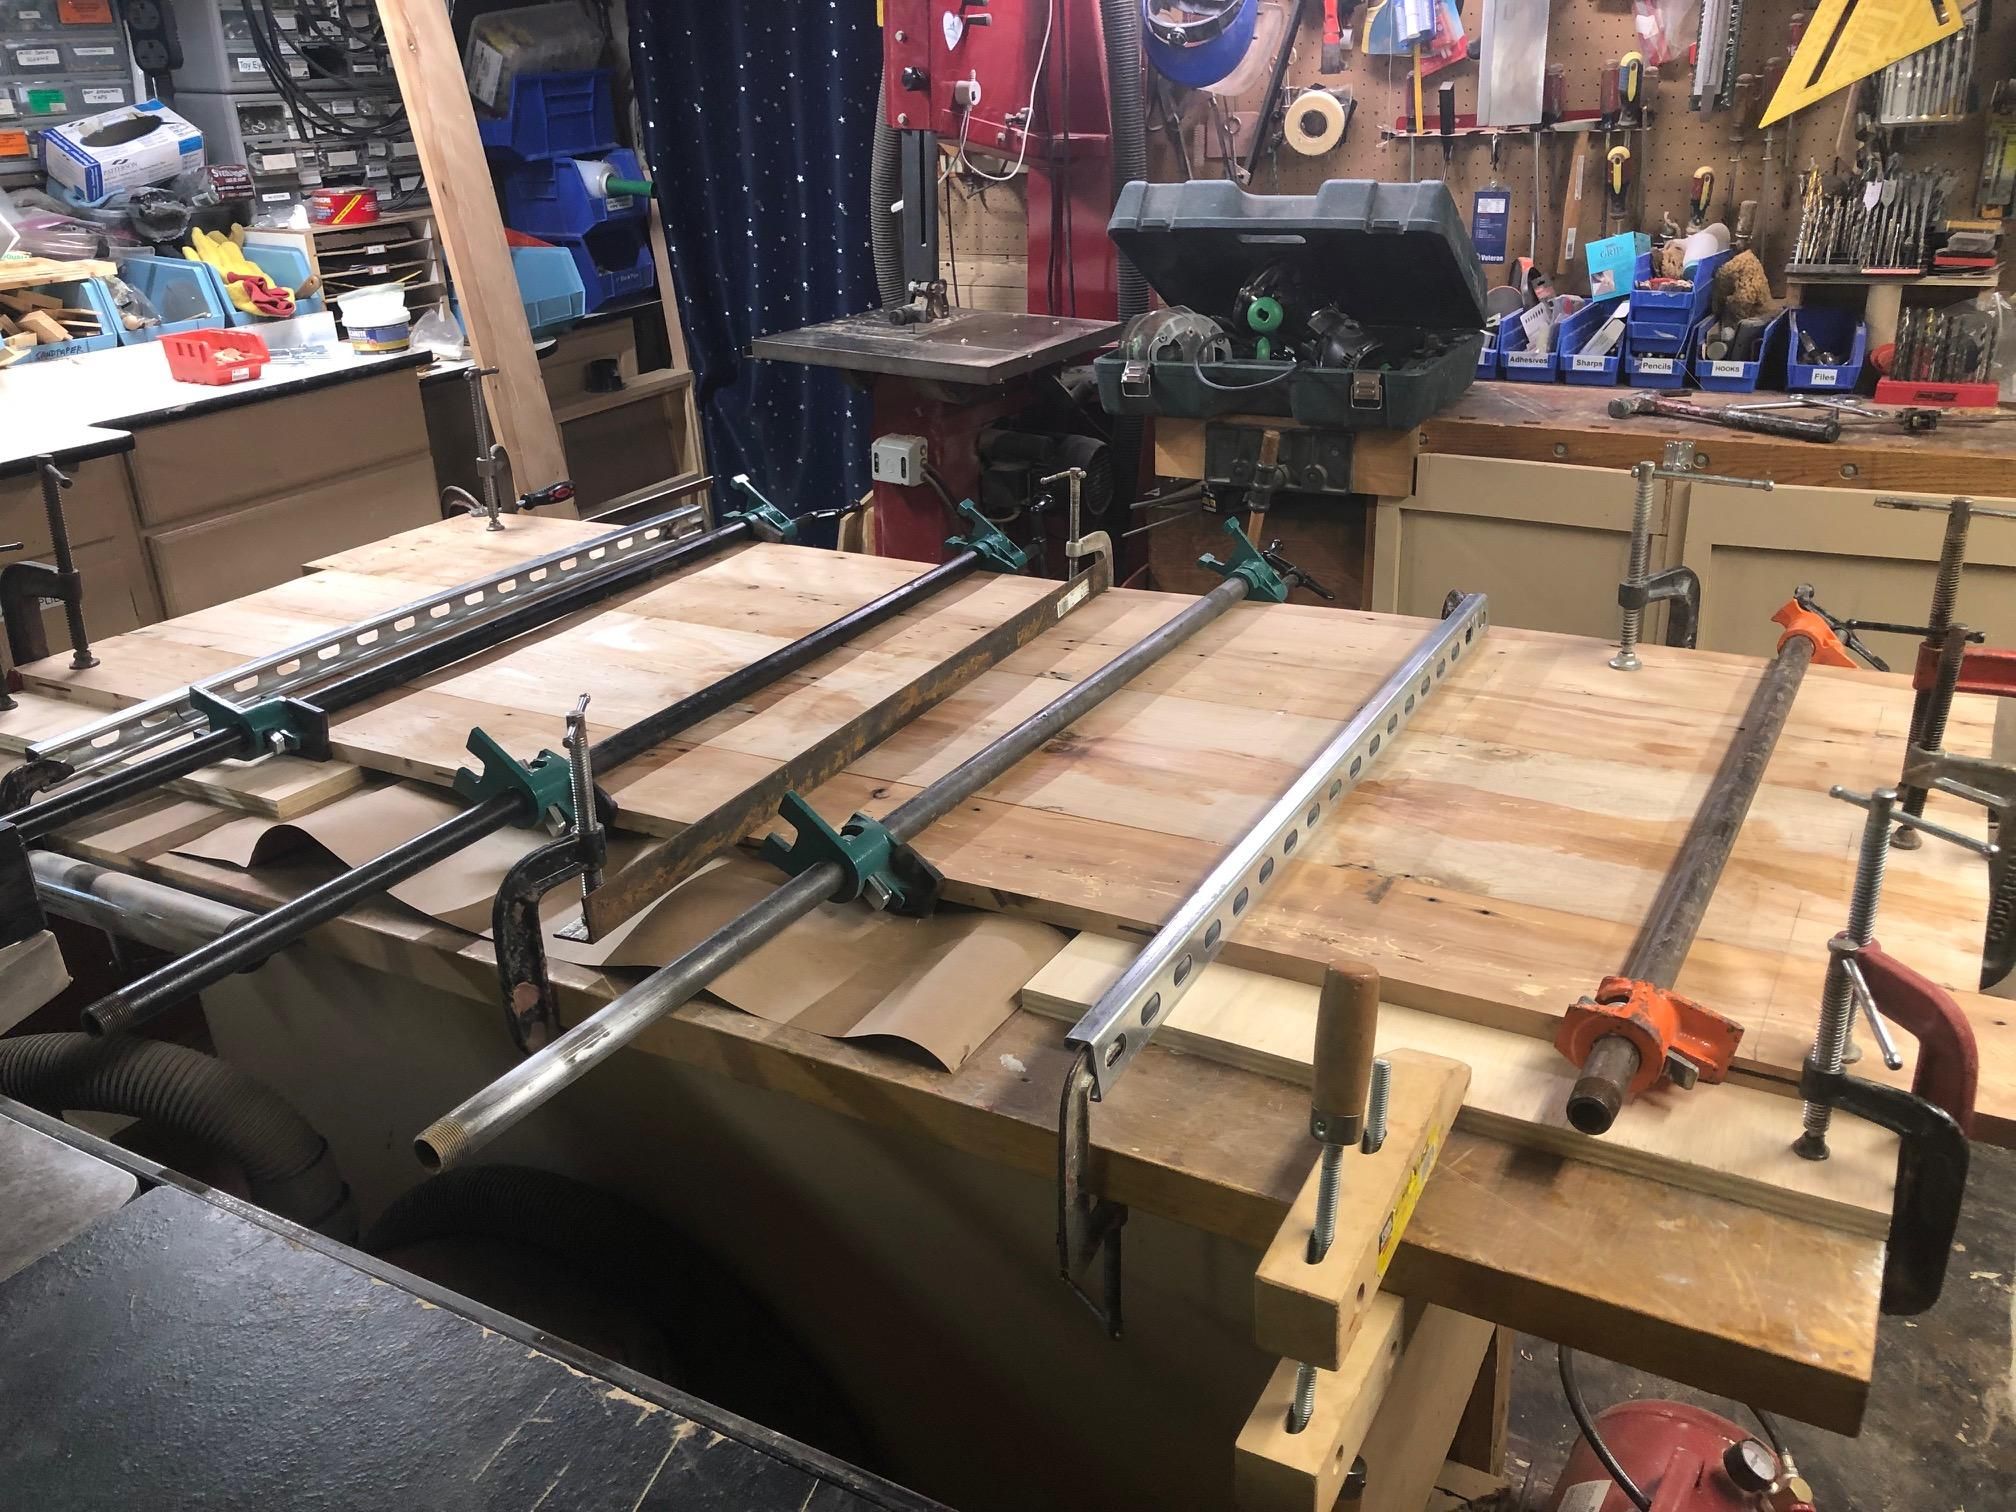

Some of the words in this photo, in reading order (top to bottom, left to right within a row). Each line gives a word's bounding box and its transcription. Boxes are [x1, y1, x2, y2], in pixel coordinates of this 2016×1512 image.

[239, 60, 251, 71] Toy
[1480, 254, 1504, 262] Veteran
[1509, 356, 1549, 365] Adhesives
[1576, 359, 1603, 368] Sharps
[1642, 362, 1672, 371] Pencils
[1715, 365, 1740, 373] HOOKS
[1814, 373, 1835, 382] Files
